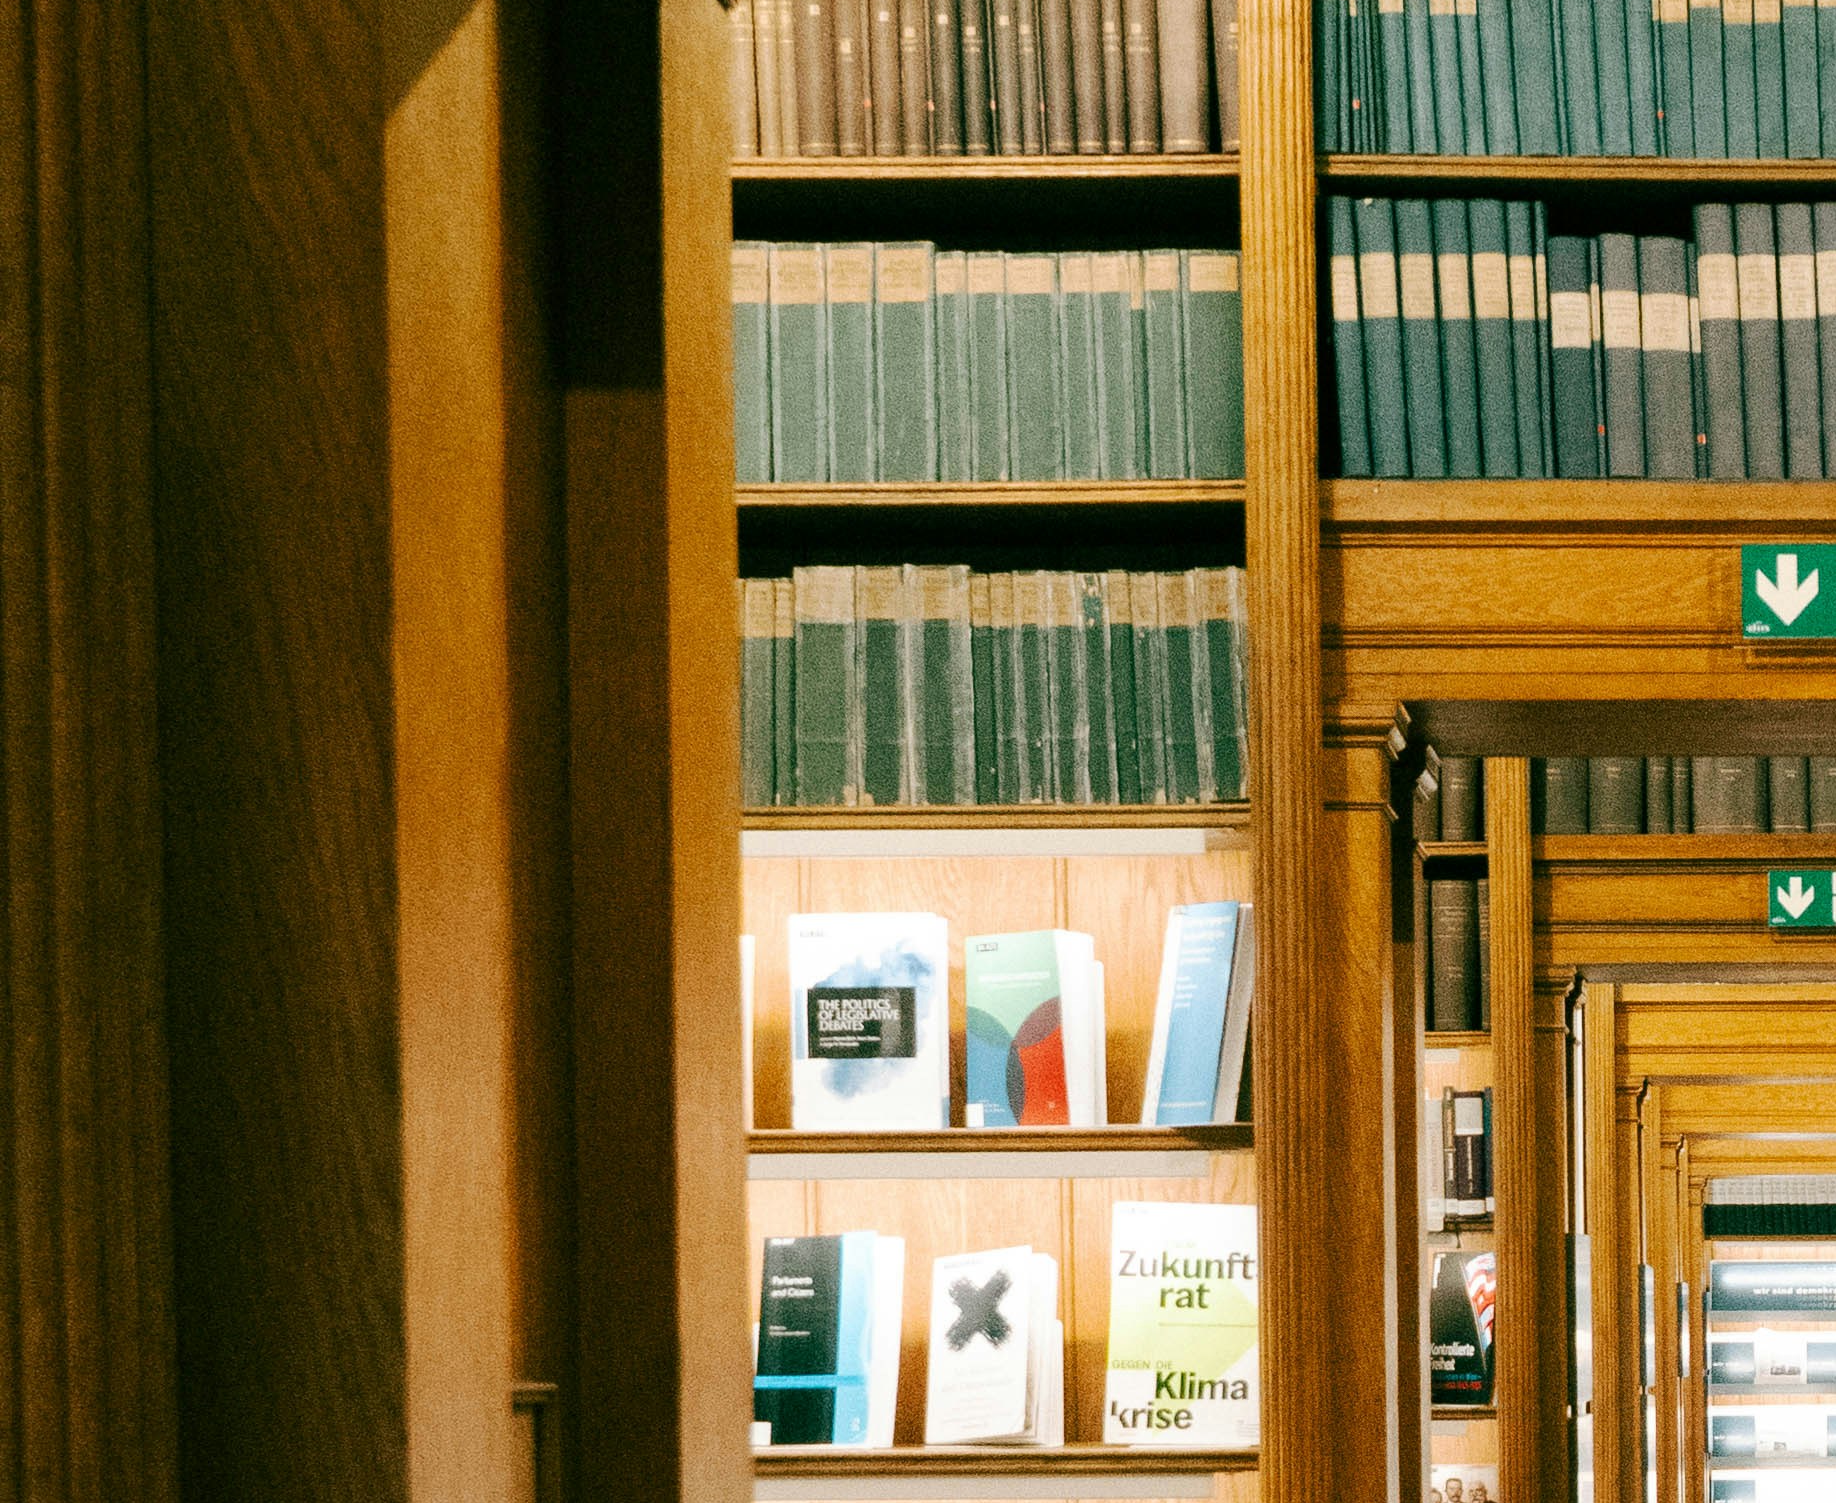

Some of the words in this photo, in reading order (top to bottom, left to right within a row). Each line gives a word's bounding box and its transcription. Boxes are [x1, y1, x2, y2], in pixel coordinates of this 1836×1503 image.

[817, 998, 840, 1010] THE
[841, 998, 891, 1010] POLITICS
[818, 1010, 837, 1020] OF
[838, 1009, 900, 1020] LEGISLATIVE
[818, 1020, 865, 1031] DEBATES
[1118, 1249, 1259, 1280] Zukunft
[1159, 1283, 1211, 1309] rat
[1753, 1286, 1772, 1295] wir
[1772, 1286, 1794, 1295] sind
[1111, 1359, 1151, 1370] GEGEN
[1154, 1371, 1249, 1400] Klima
[1111, 1400, 1193, 1429] krise
